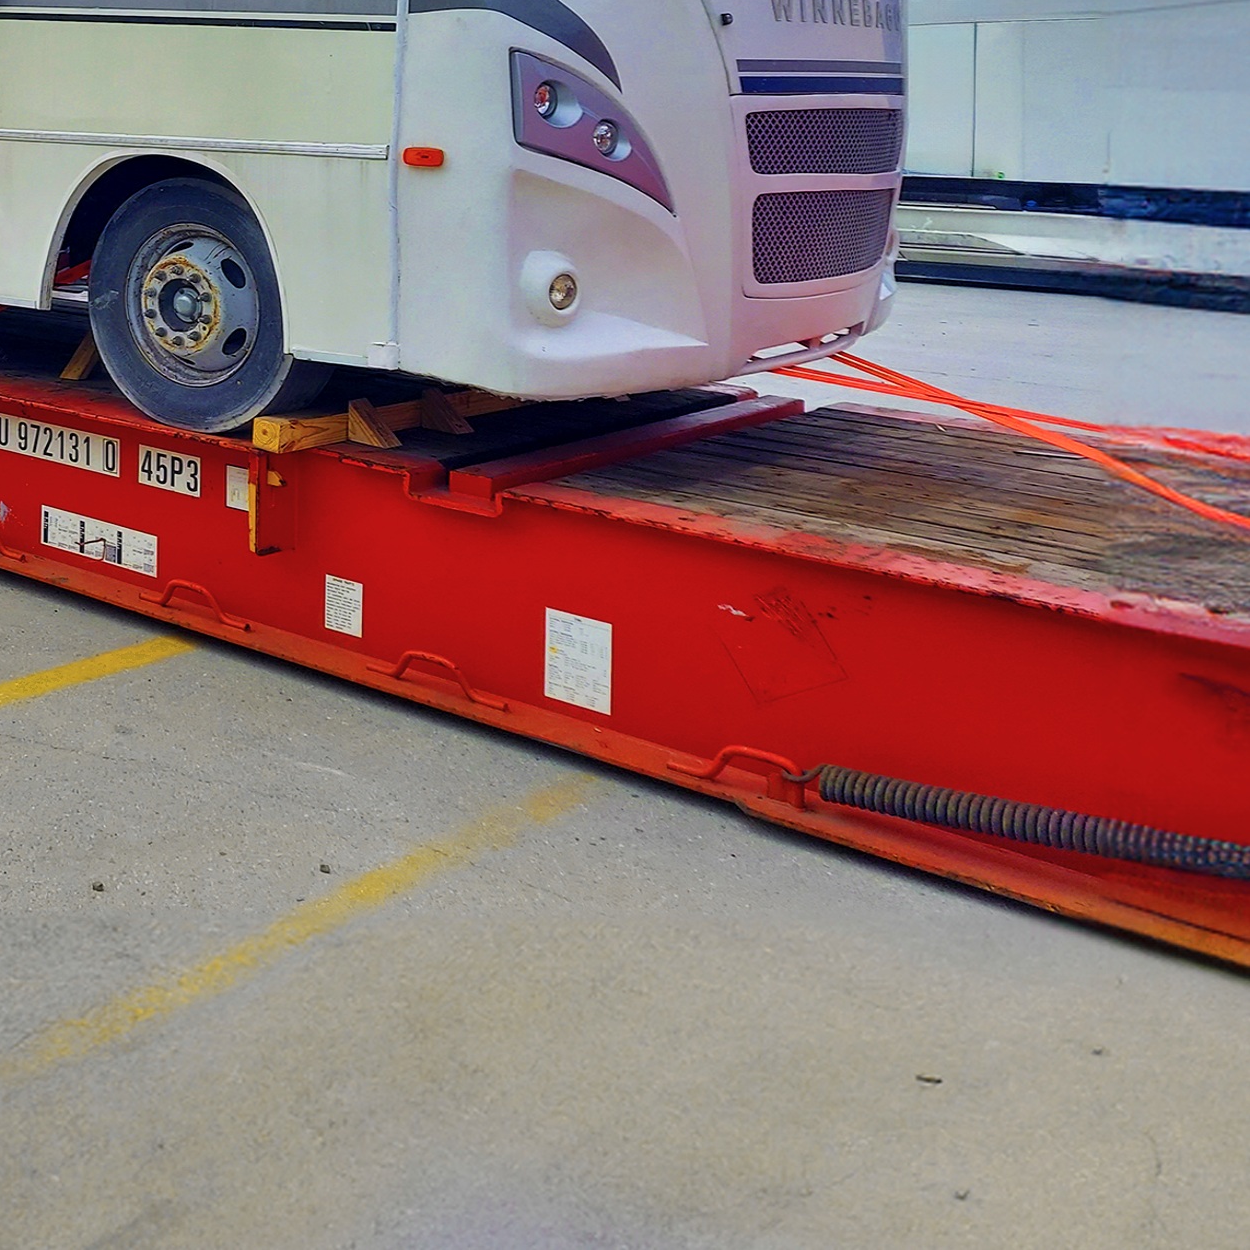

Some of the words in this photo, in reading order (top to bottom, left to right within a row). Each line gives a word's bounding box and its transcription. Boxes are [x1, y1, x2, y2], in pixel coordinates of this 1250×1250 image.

[18, 421, 91, 466] 972131
[105, 440, 116, 472] 0
[141, 450, 199, 492] 45P3
